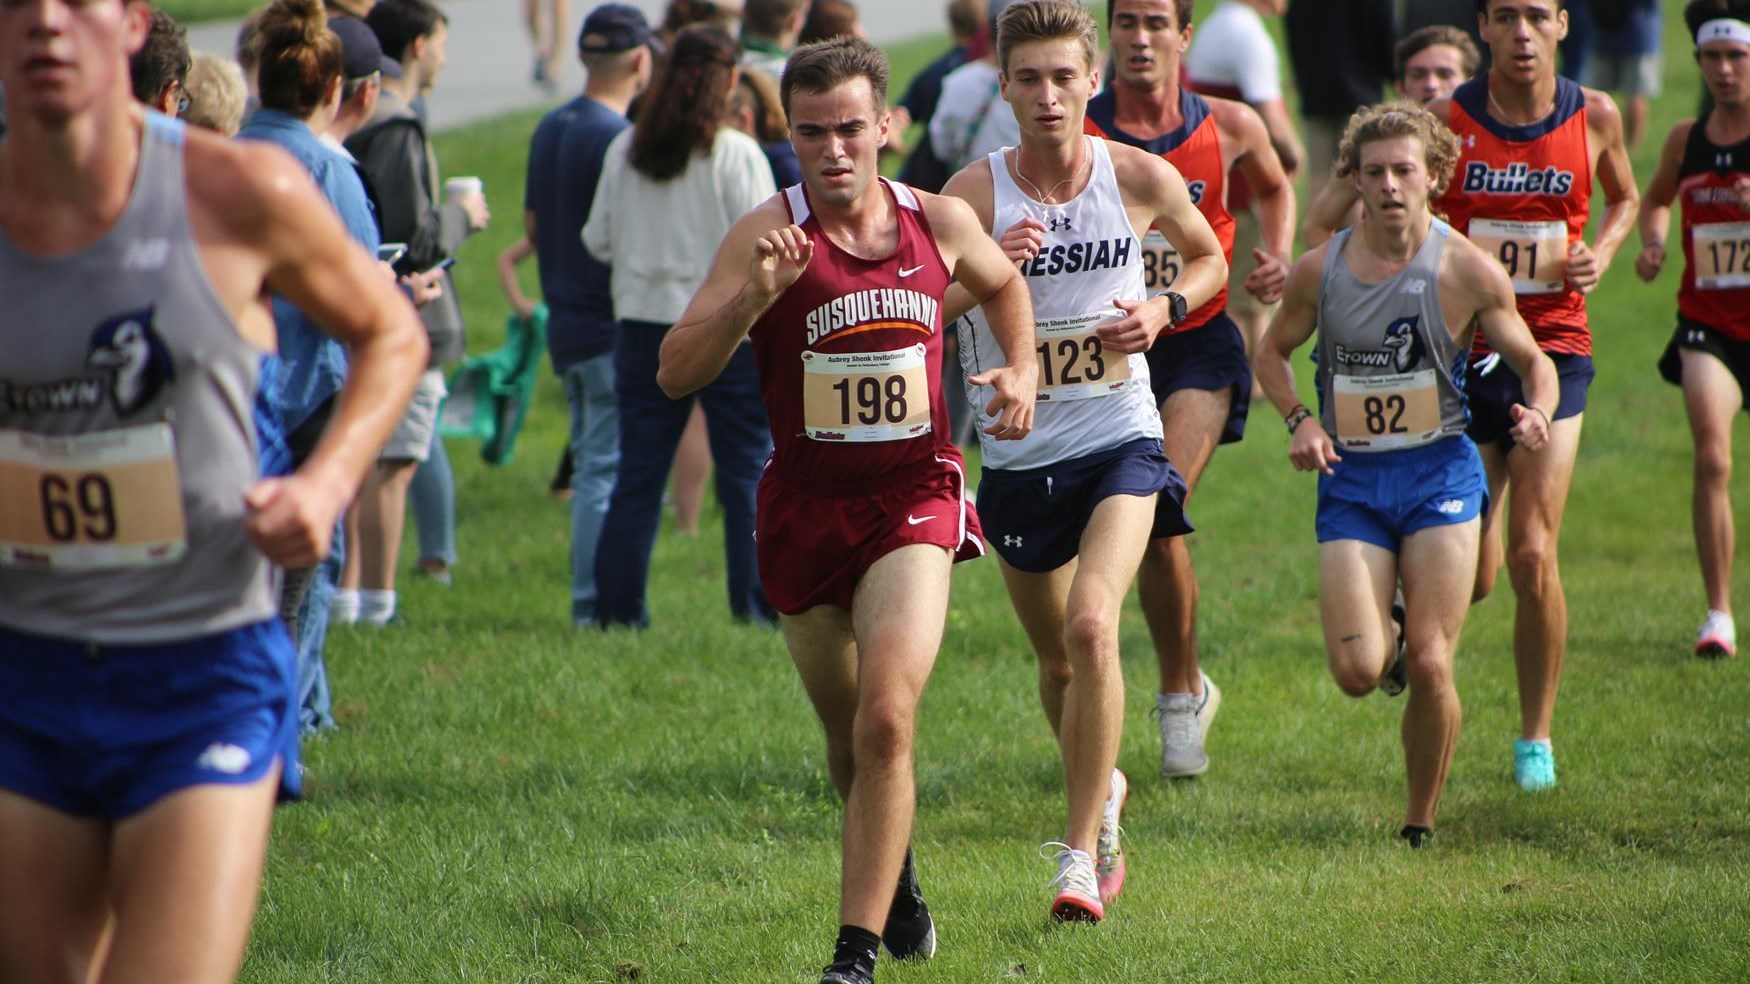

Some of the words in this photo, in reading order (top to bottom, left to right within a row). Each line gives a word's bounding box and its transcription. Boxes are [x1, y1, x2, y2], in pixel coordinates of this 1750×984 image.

[1462, 161, 1574, 196] Bullets
[1021, 237, 1131, 277] ESSIAH
[1500, 240, 1537, 279] 91
[828, 356, 850, 364] Aubrey
[852, 354, 871, 362] Shenk
[873, 352, 906, 361] Invitational
[1037, 336, 1105, 386] 123
[833, 375, 907, 425] 198
[1364, 395, 1408, 435] 82
[40, 473, 118, 543] 69
